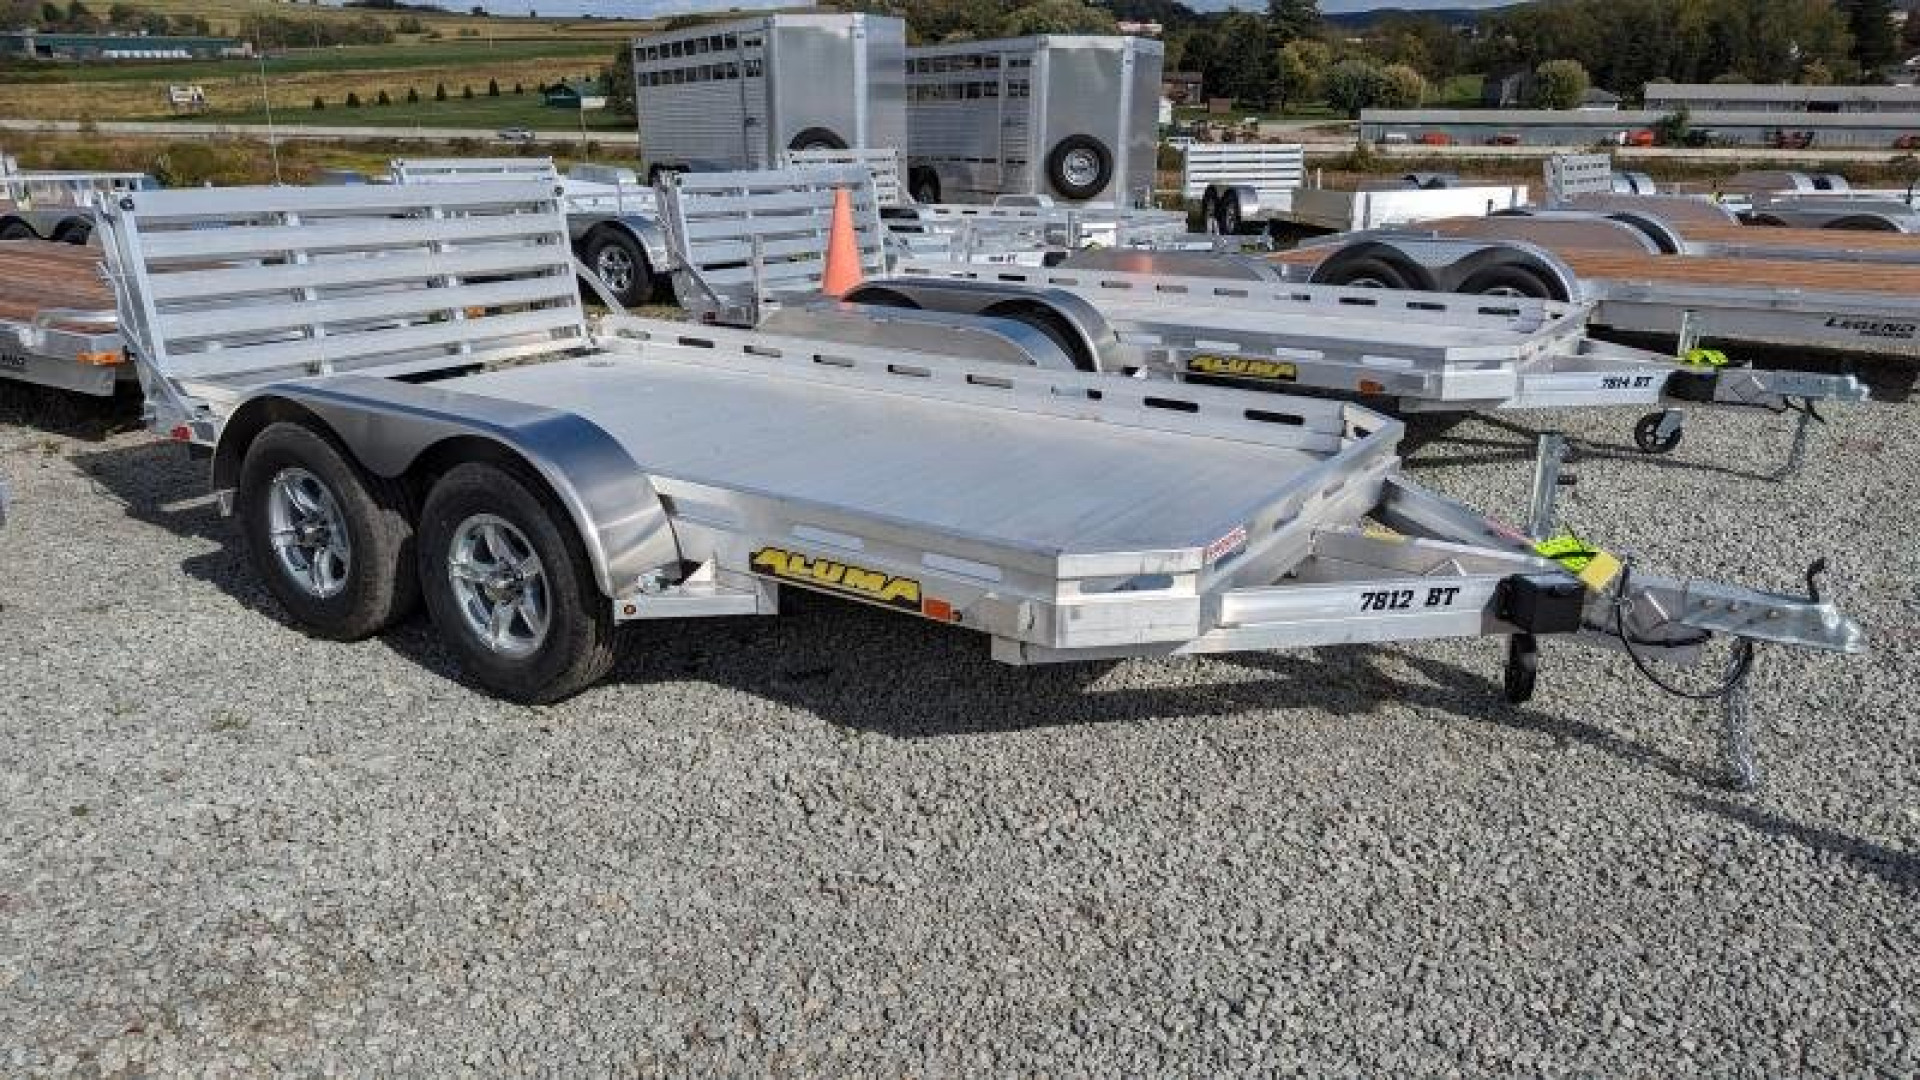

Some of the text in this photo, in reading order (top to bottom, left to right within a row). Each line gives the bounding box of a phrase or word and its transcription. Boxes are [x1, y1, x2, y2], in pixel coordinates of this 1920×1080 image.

[1824, 316, 1916, 332] LEGEND
[1187, 354, 1296, 380] ALUMA
[1633, 376, 1654, 387] BT
[750, 548, 921, 610] ALUMA
[1361, 587, 1460, 611] 7812 BT
